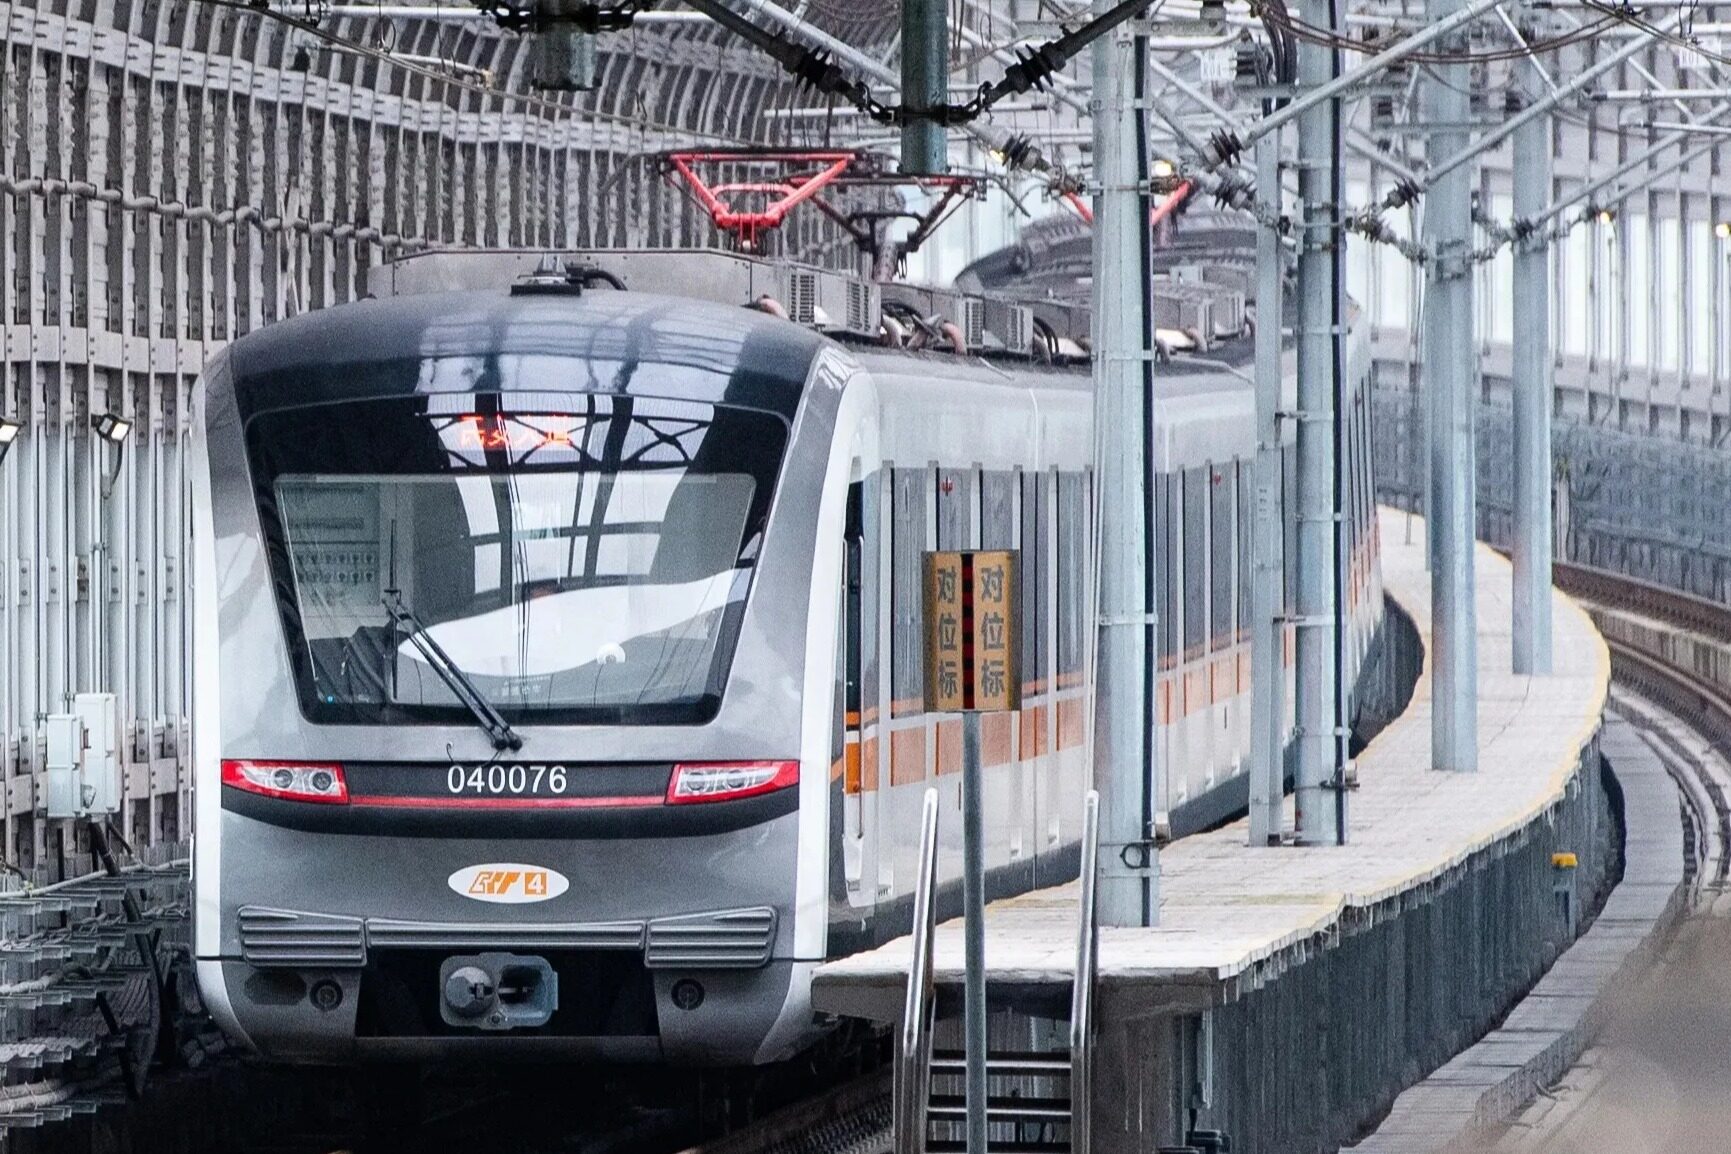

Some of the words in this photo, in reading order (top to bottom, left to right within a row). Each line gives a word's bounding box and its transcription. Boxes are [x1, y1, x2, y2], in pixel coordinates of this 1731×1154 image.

[938, 566, 958, 698] 对位标
[981, 565, 1005, 698] 对位标
[447, 765, 567, 793] 040076
[527, 873, 546, 895] 4
